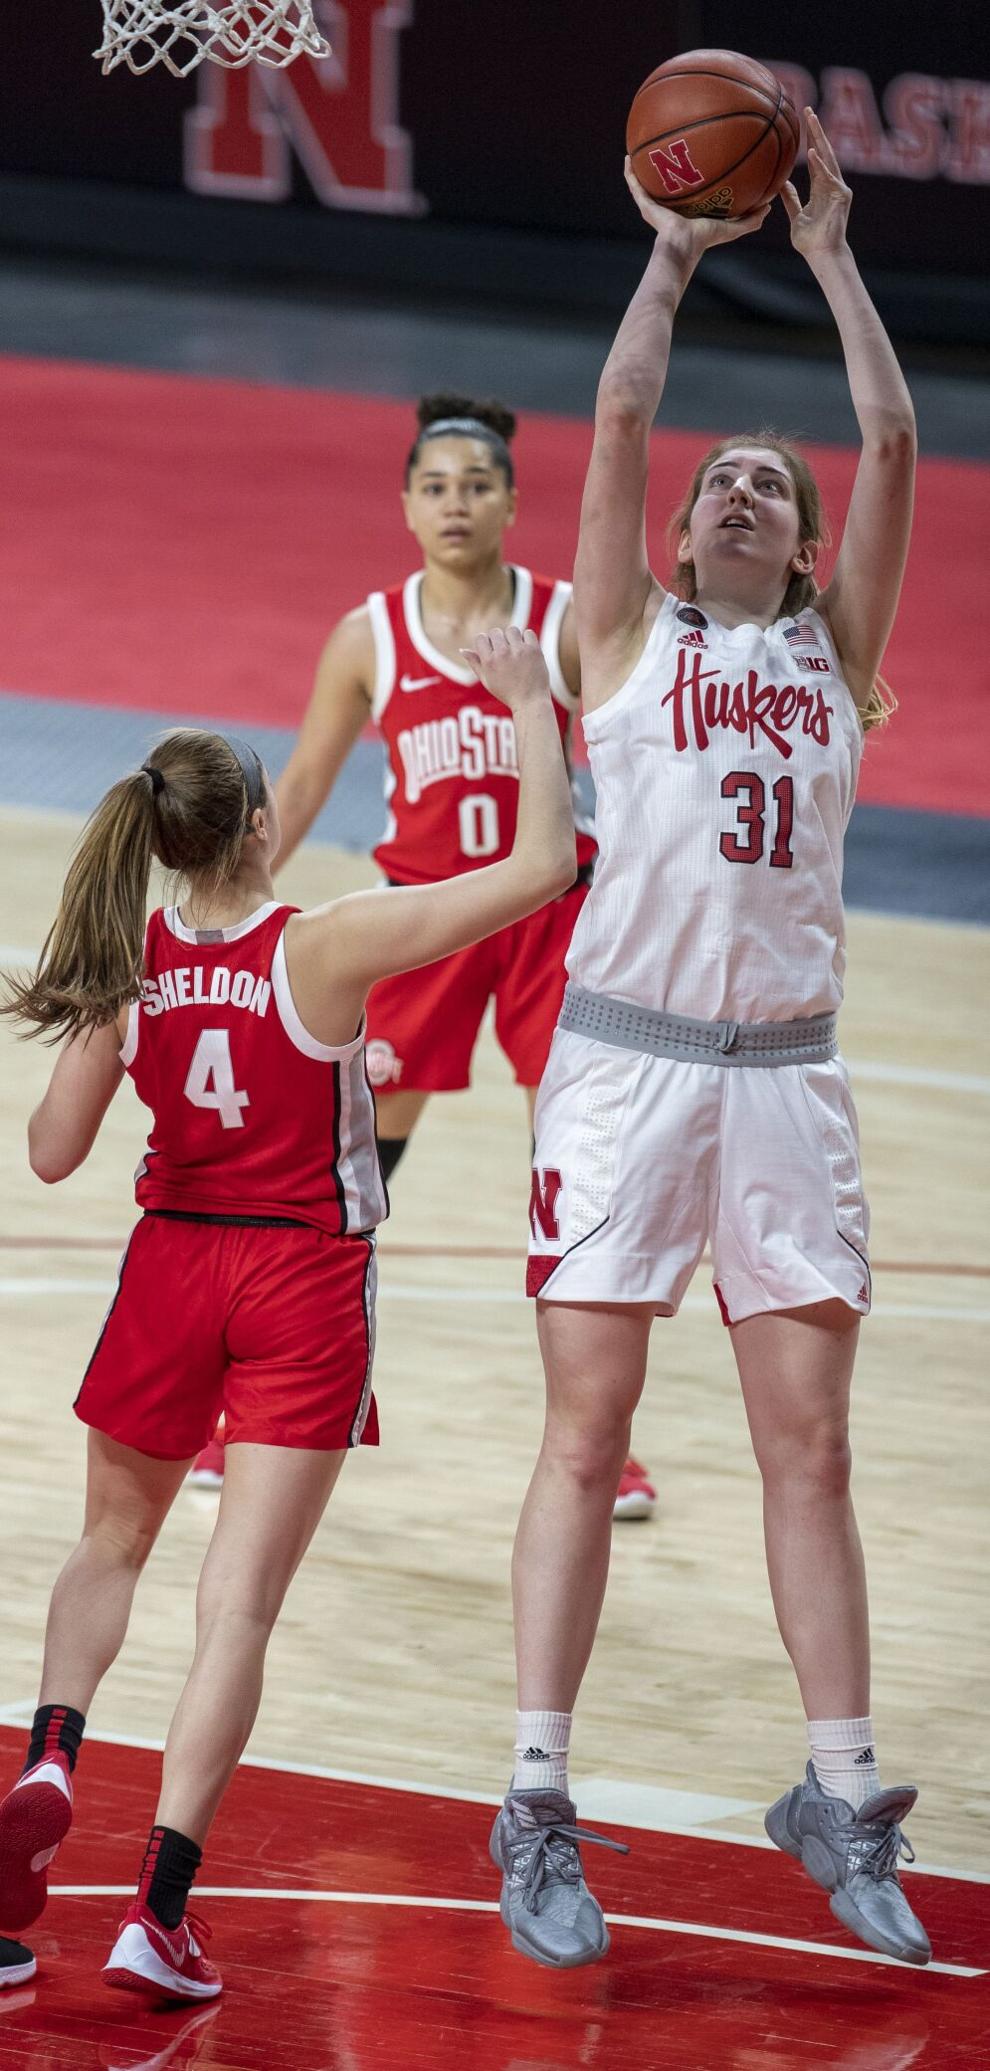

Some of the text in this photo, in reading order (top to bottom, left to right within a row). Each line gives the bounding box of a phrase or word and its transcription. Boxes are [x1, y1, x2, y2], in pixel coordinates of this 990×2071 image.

[648, 139, 704, 193] N
[677, 637, 709, 650] adidas
[661, 648, 834, 760] Huskers
[458, 793, 500, 858] 0
[719, 771, 794, 869] 31
[142, 966, 271, 1017] SHELDON
[183, 1028, 250, 1129] 4
[528, 1168, 562, 1241] N
